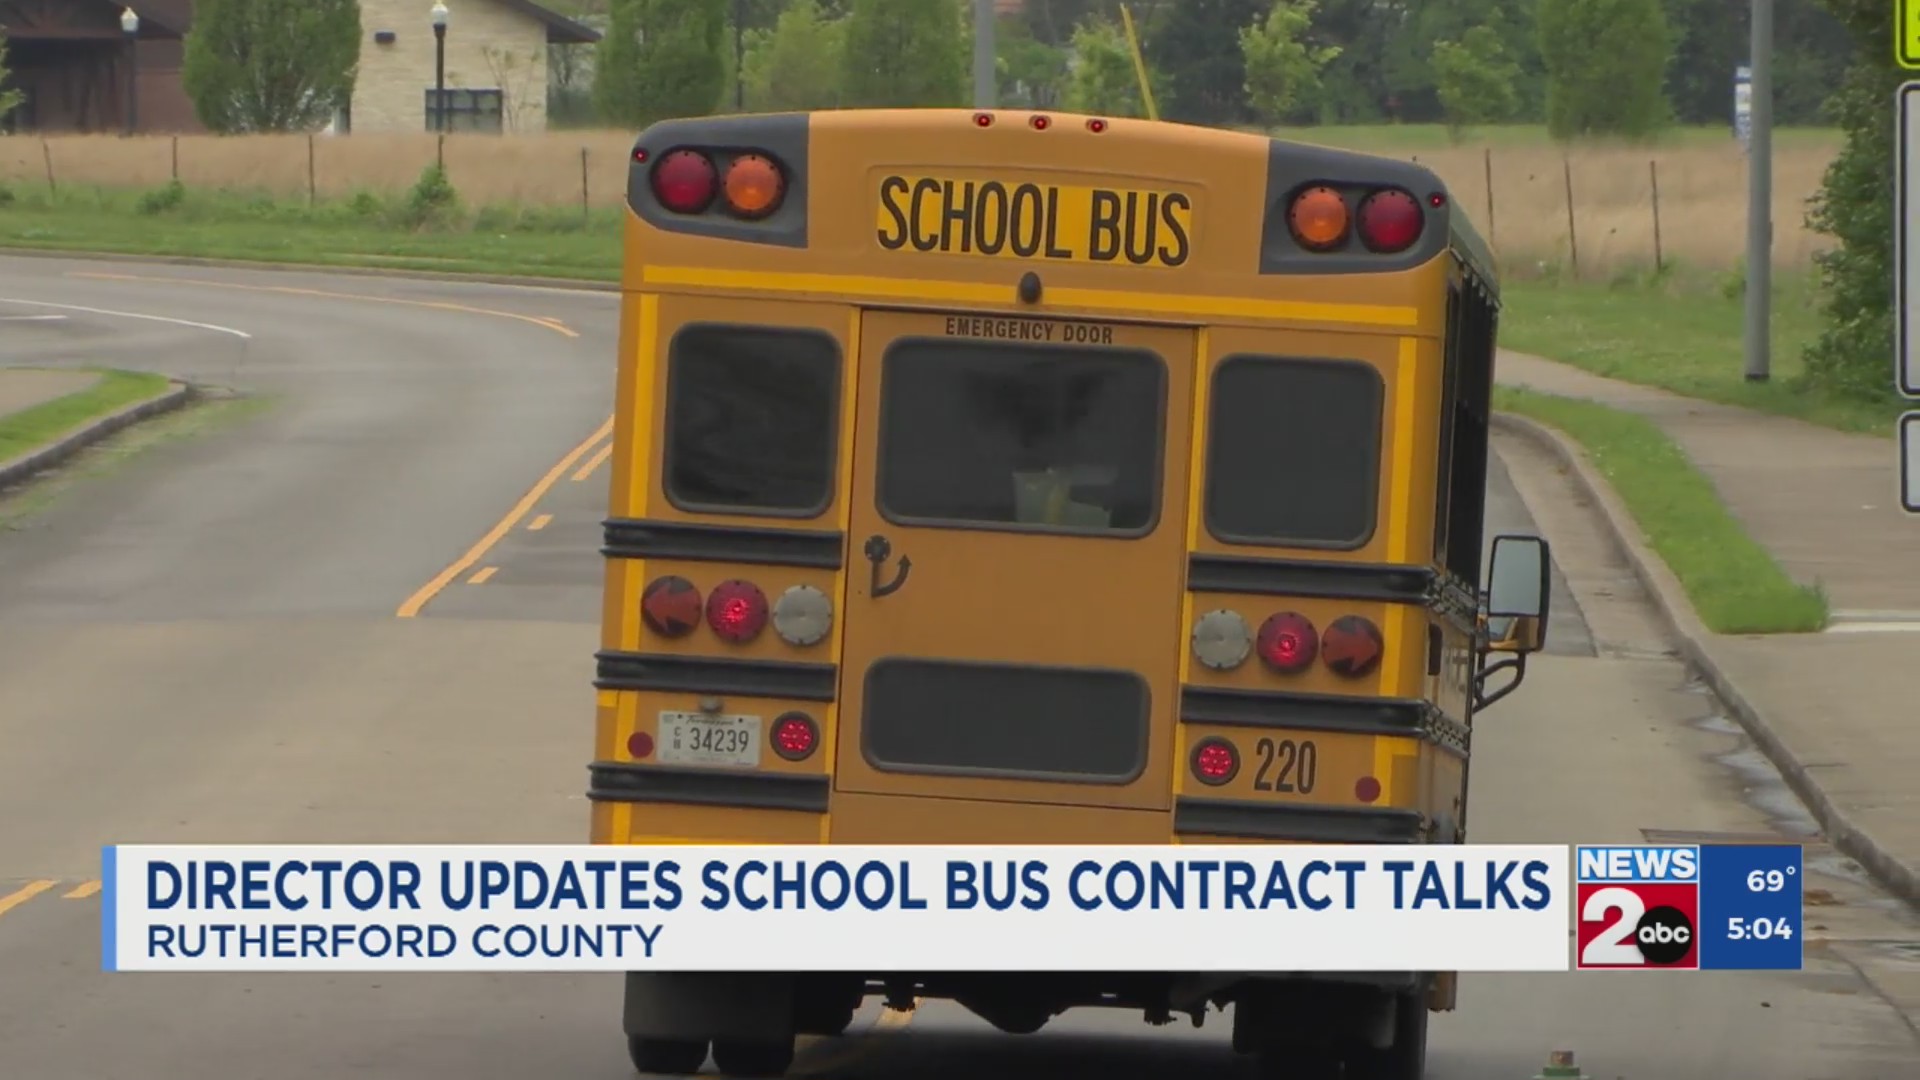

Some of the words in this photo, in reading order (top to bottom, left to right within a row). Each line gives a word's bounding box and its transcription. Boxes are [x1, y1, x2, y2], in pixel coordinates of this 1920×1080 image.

[877, 175, 1072, 259] SCHOOL
[1088, 189, 1190, 267] BUS
[945, 316, 1055, 342] EMERGENCY
[1062, 324, 1113, 345] DOOR
[689, 727, 749, 753] 34239
[1254, 737, 1316, 795] 220
